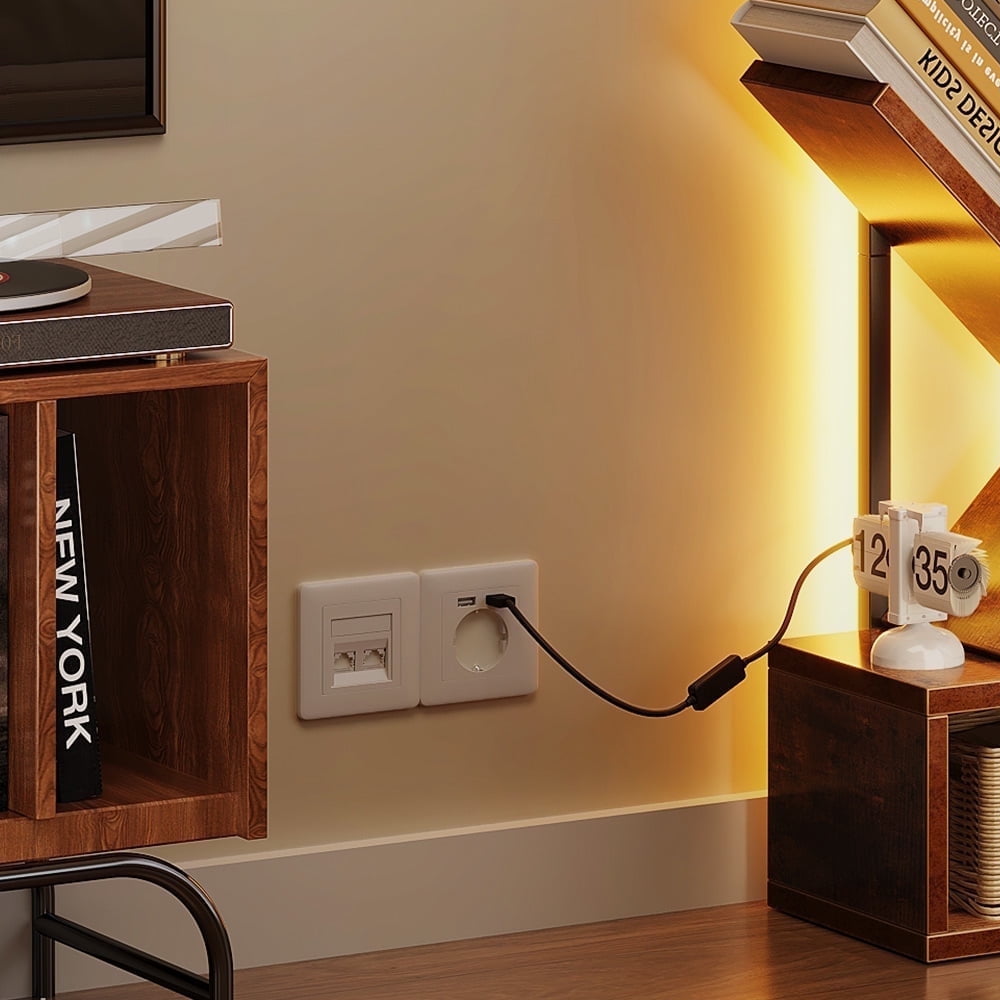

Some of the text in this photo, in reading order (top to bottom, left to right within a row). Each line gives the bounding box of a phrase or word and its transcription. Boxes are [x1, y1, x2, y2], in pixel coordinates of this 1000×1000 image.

[855, 529, 887, 579] 12
[915, 545, 949, 596] 35
[56, 498, 92, 750] NEW YORK
